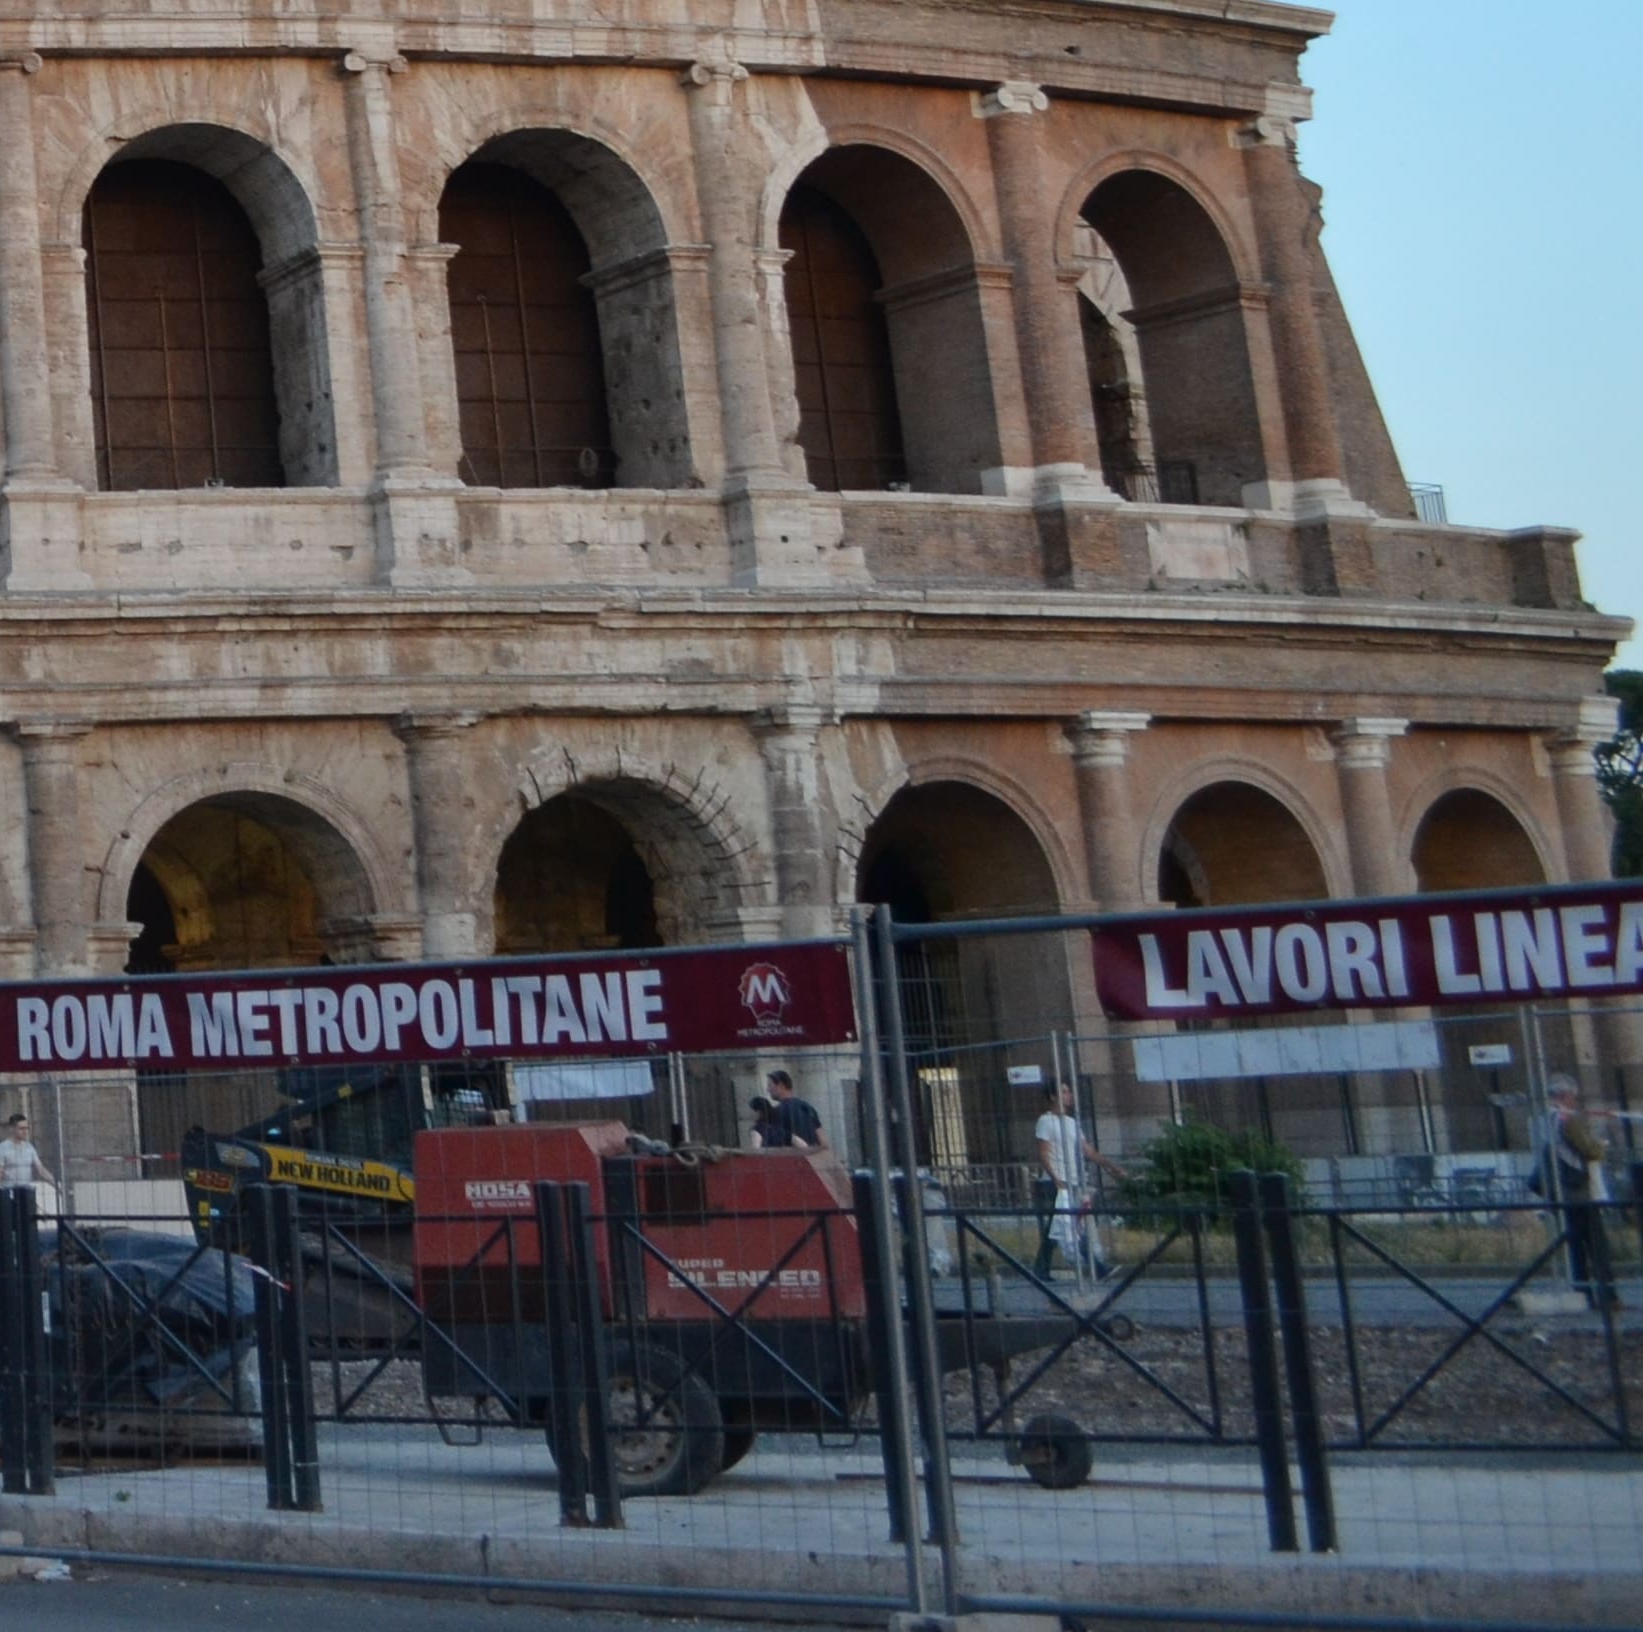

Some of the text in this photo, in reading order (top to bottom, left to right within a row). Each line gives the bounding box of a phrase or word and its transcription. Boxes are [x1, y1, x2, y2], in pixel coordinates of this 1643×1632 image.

[1137, 918, 1410, 1009] LAVORI
[16, 968, 668, 1062] ROMA METROPOLITANE
[277, 1159, 314, 1180] NEW
[317, 1165, 392, 1192] HOLLAND
[668, 1257, 725, 1269] UPER
